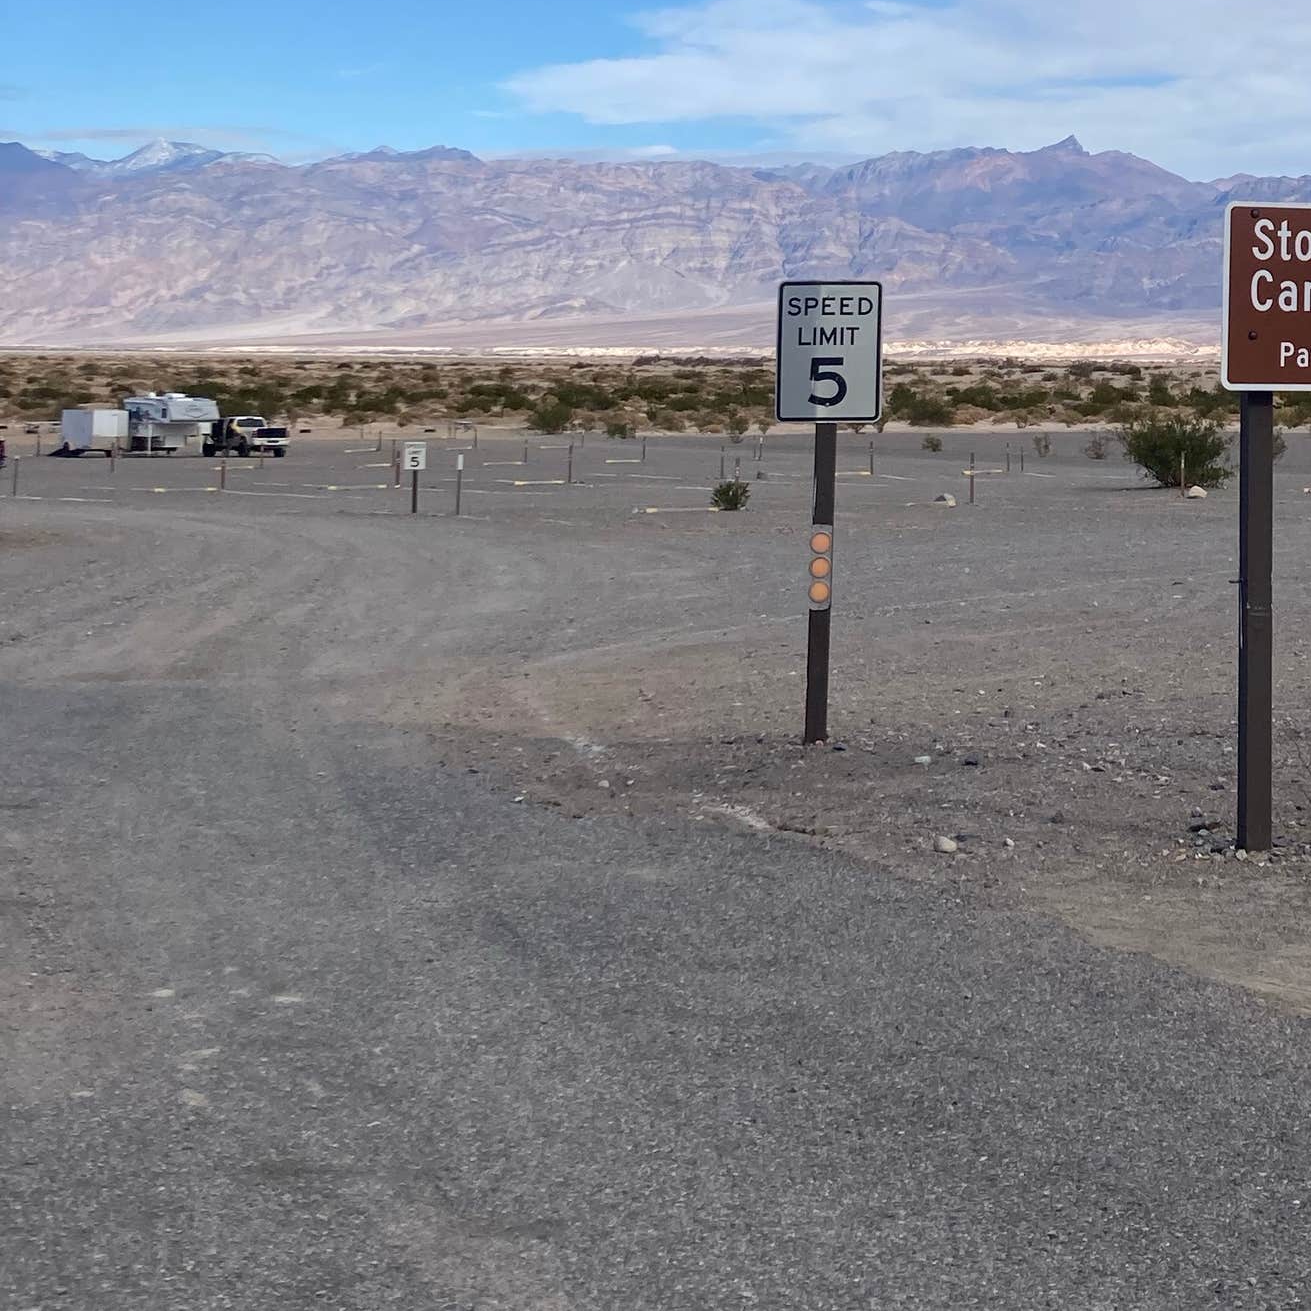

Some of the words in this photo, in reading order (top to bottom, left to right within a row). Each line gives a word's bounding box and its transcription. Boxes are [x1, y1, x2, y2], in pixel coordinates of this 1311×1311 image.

[787, 296, 874, 317] SPEED
[798, 326, 860, 346] LIMIT
[808, 357, 848, 408] 5
[410, 456, 420, 468] 5
